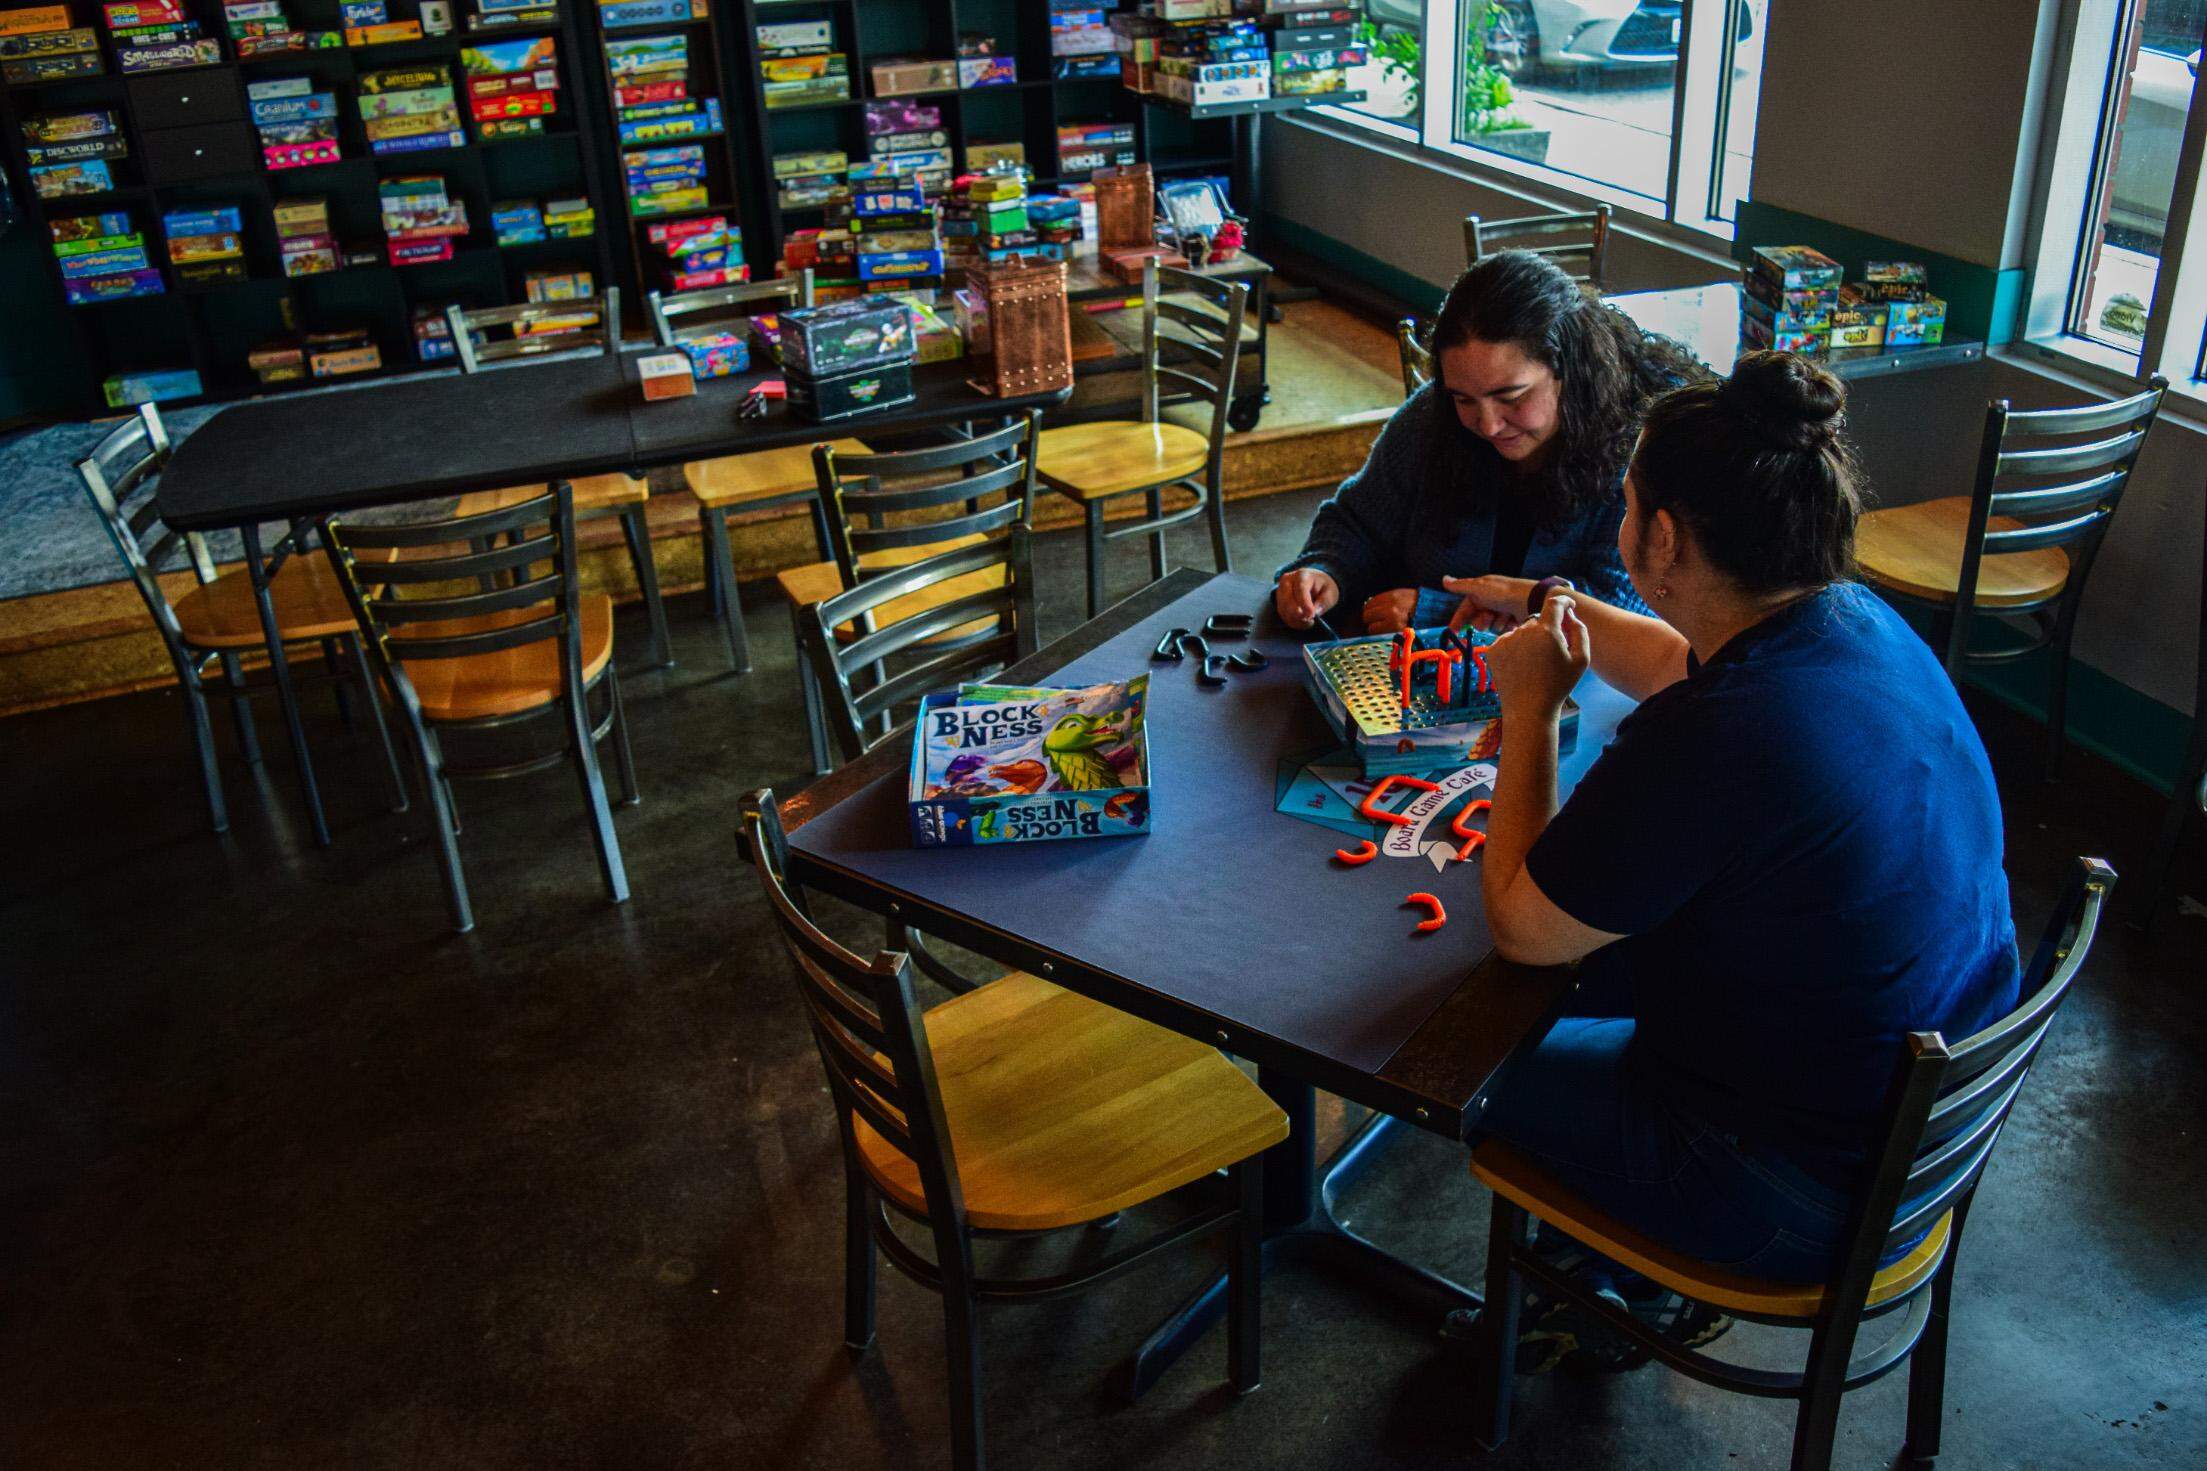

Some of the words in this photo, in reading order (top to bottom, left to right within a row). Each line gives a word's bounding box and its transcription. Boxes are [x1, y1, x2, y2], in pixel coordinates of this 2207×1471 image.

[1834, 310, 1861, 323] epic
[934, 703, 1041, 737] BLOCK
[960, 720, 1043, 748] NESS
[1410, 789, 1449, 817] Game
[1447, 768, 1488, 790] Café
[1007, 799, 1079, 823] NESS
[1012, 811, 1103, 839] BLOCK
